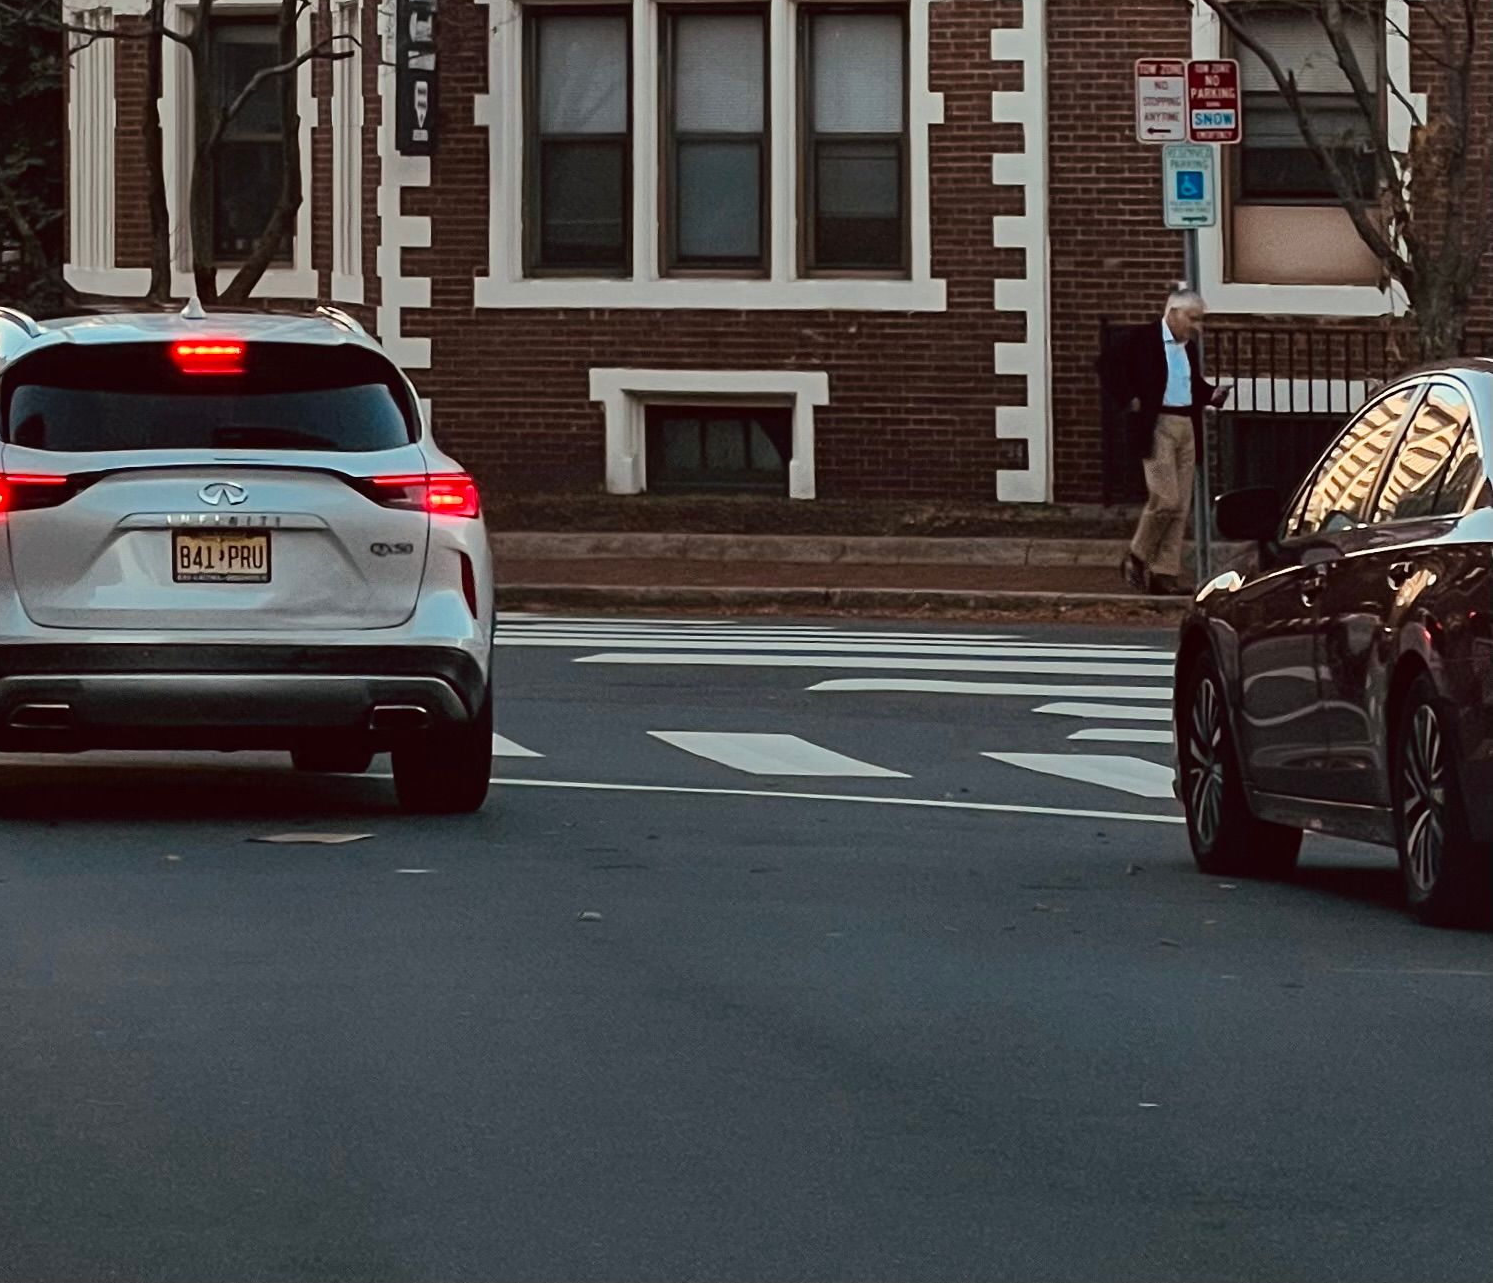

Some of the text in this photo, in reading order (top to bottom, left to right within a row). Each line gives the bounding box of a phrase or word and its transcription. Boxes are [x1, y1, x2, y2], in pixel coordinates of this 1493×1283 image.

[1154, 81, 1168, 90] NO
[1204, 75, 1220, 86] NO
[1190, 88, 1236, 99] PARKING
[1194, 113, 1233, 125] SNOW
[180, 545, 264, 570] B41 PRU
